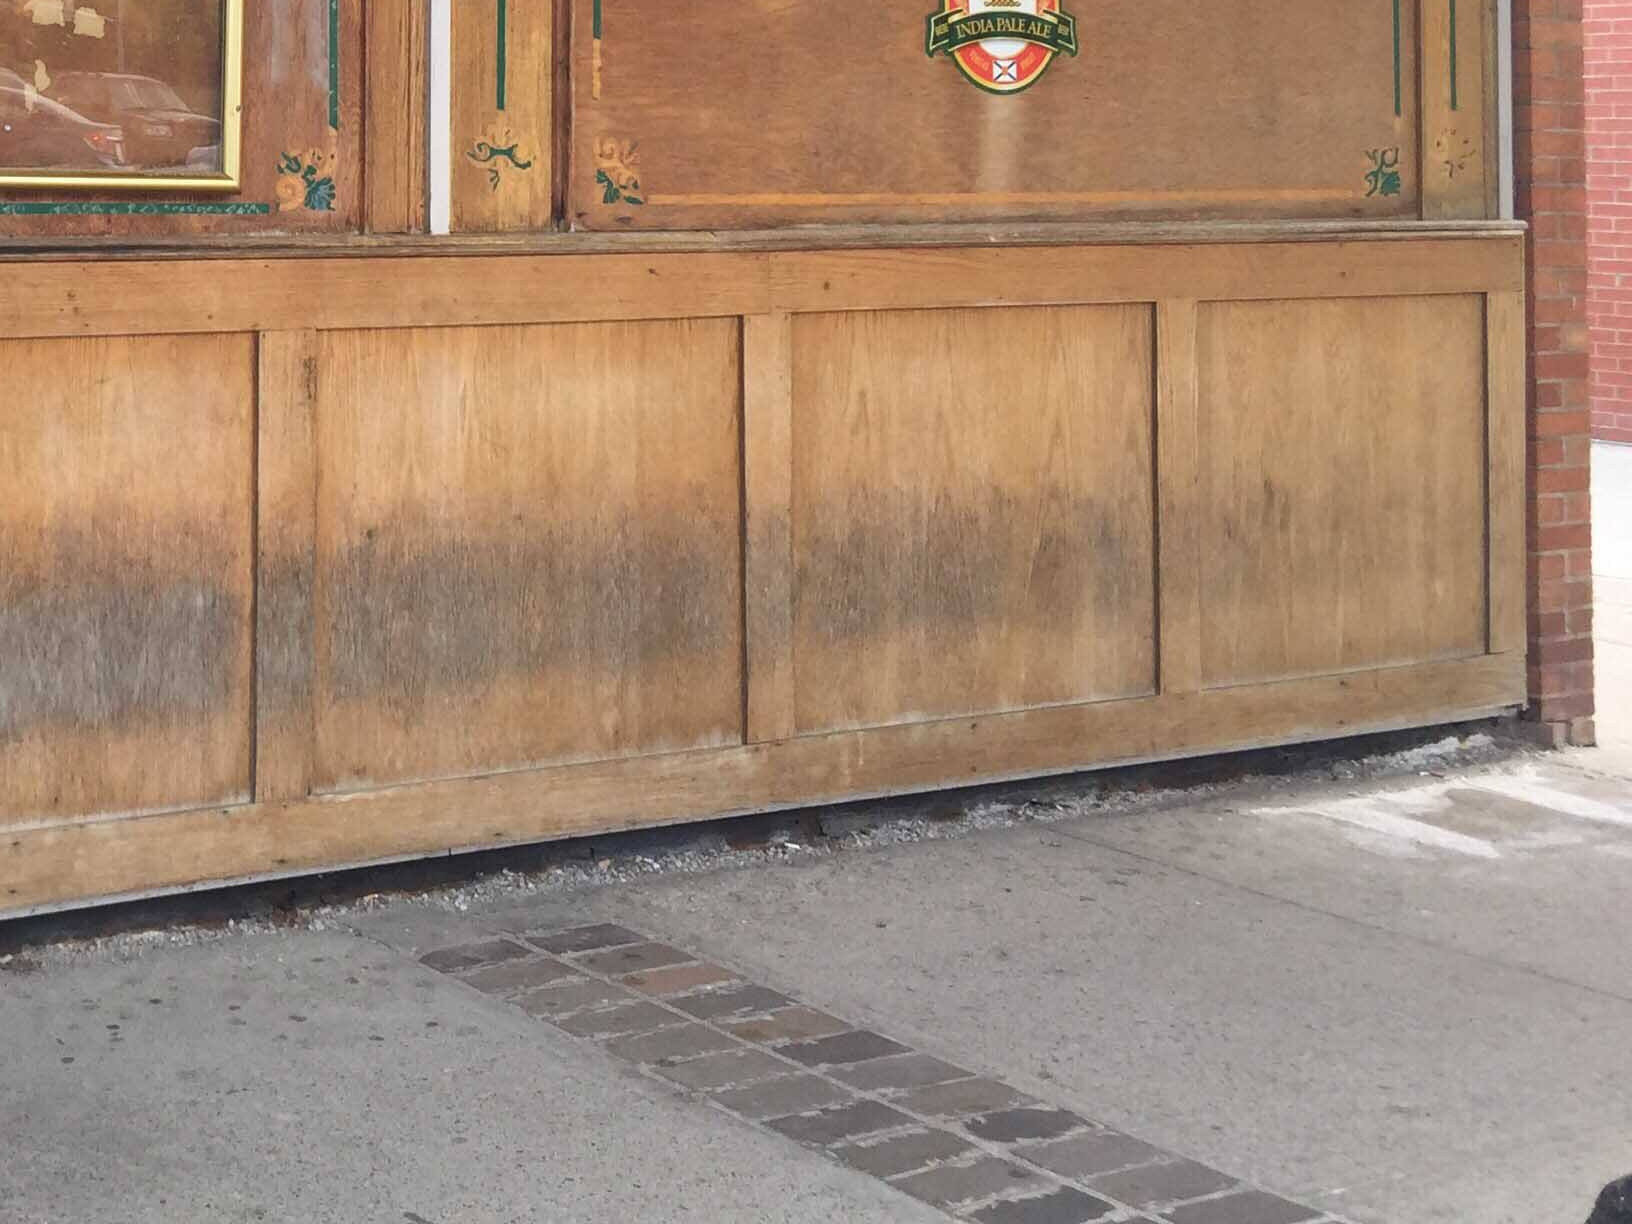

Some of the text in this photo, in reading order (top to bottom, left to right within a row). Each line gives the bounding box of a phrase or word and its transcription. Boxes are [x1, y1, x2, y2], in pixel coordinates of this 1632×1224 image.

[956, 19, 995, 39] INDIA
[996, 17, 1027, 33] PALE
[1027, 19, 1052, 39] ALE
